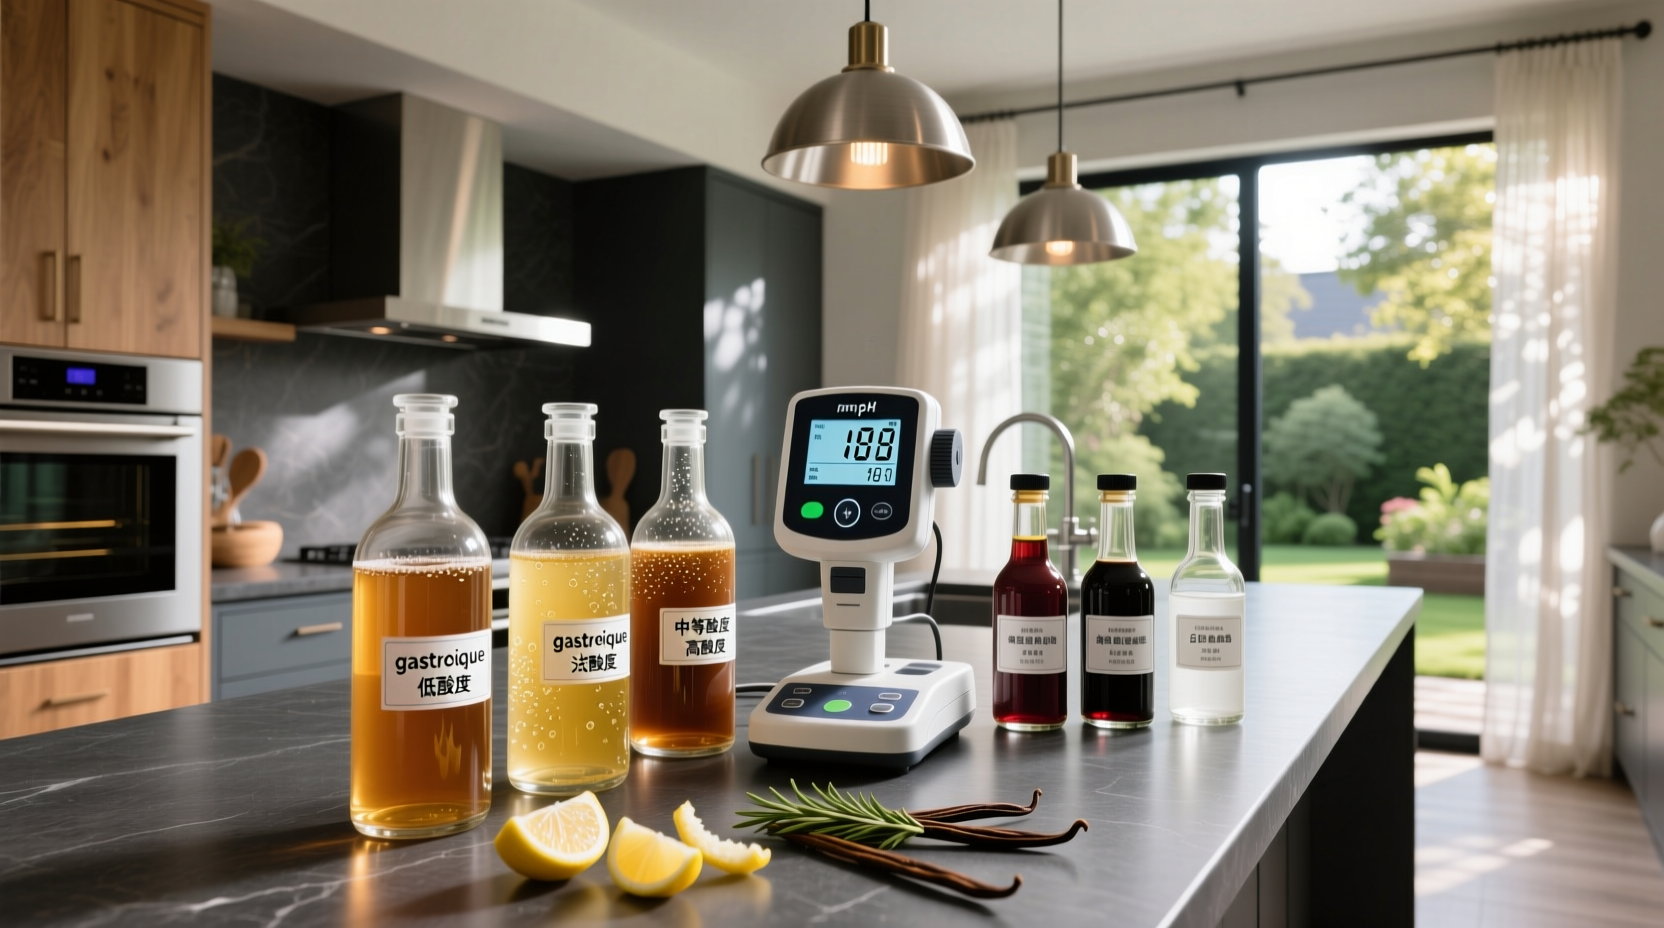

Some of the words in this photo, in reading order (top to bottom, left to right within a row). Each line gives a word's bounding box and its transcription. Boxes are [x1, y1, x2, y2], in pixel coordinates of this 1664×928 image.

[844, 427, 896, 461] 188
[395, 648, 485, 675] gastroique
[417, 674, 471, 698] 低酸度
